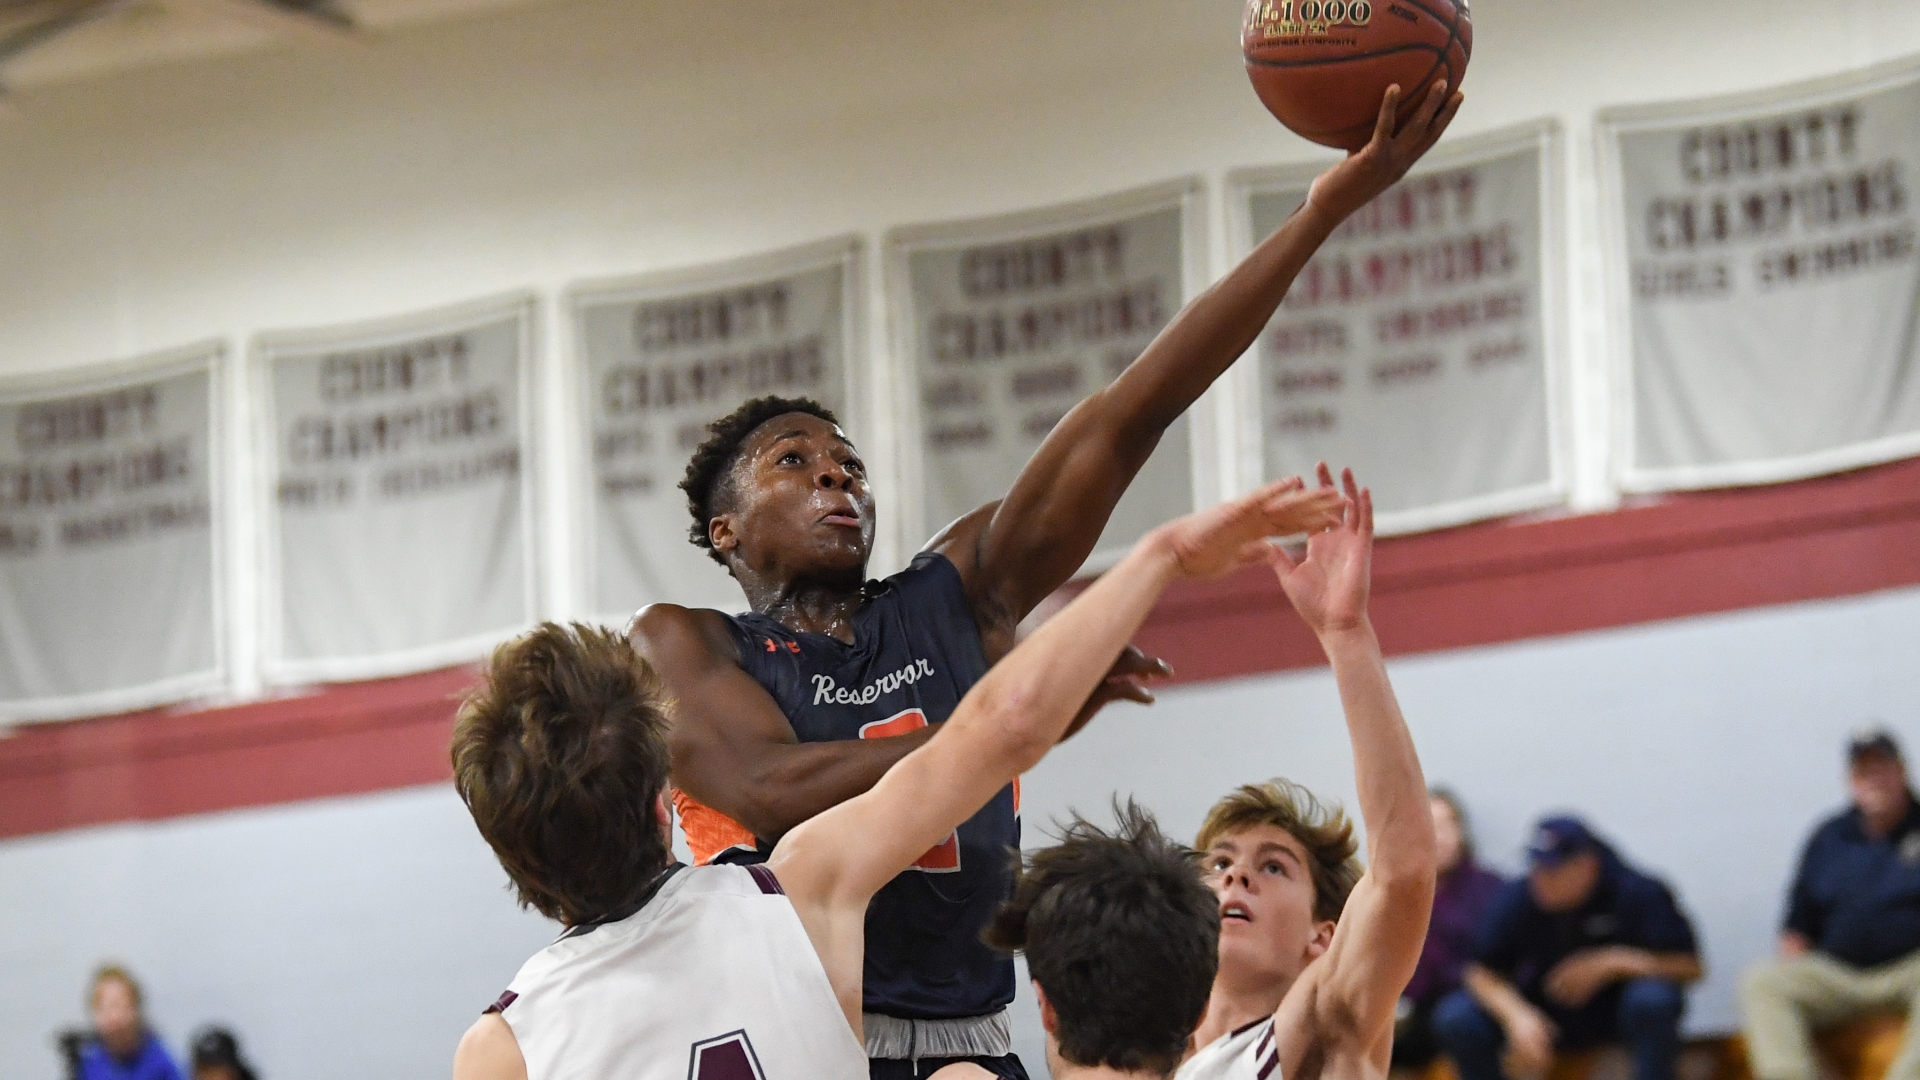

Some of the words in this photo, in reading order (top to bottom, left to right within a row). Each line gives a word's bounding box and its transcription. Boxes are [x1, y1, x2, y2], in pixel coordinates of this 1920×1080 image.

[1679, 102, 1859, 185] COUNTY
[1338, 166, 1478, 240] UNTY
[1646, 158, 1906, 252] CHAMPIONS
[960, 222, 1124, 300] COUNTY
[633, 281, 790, 352] COUNTY
[928, 278, 1162, 365] CHAMPIONS
[318, 335, 467, 404] COUNTY
